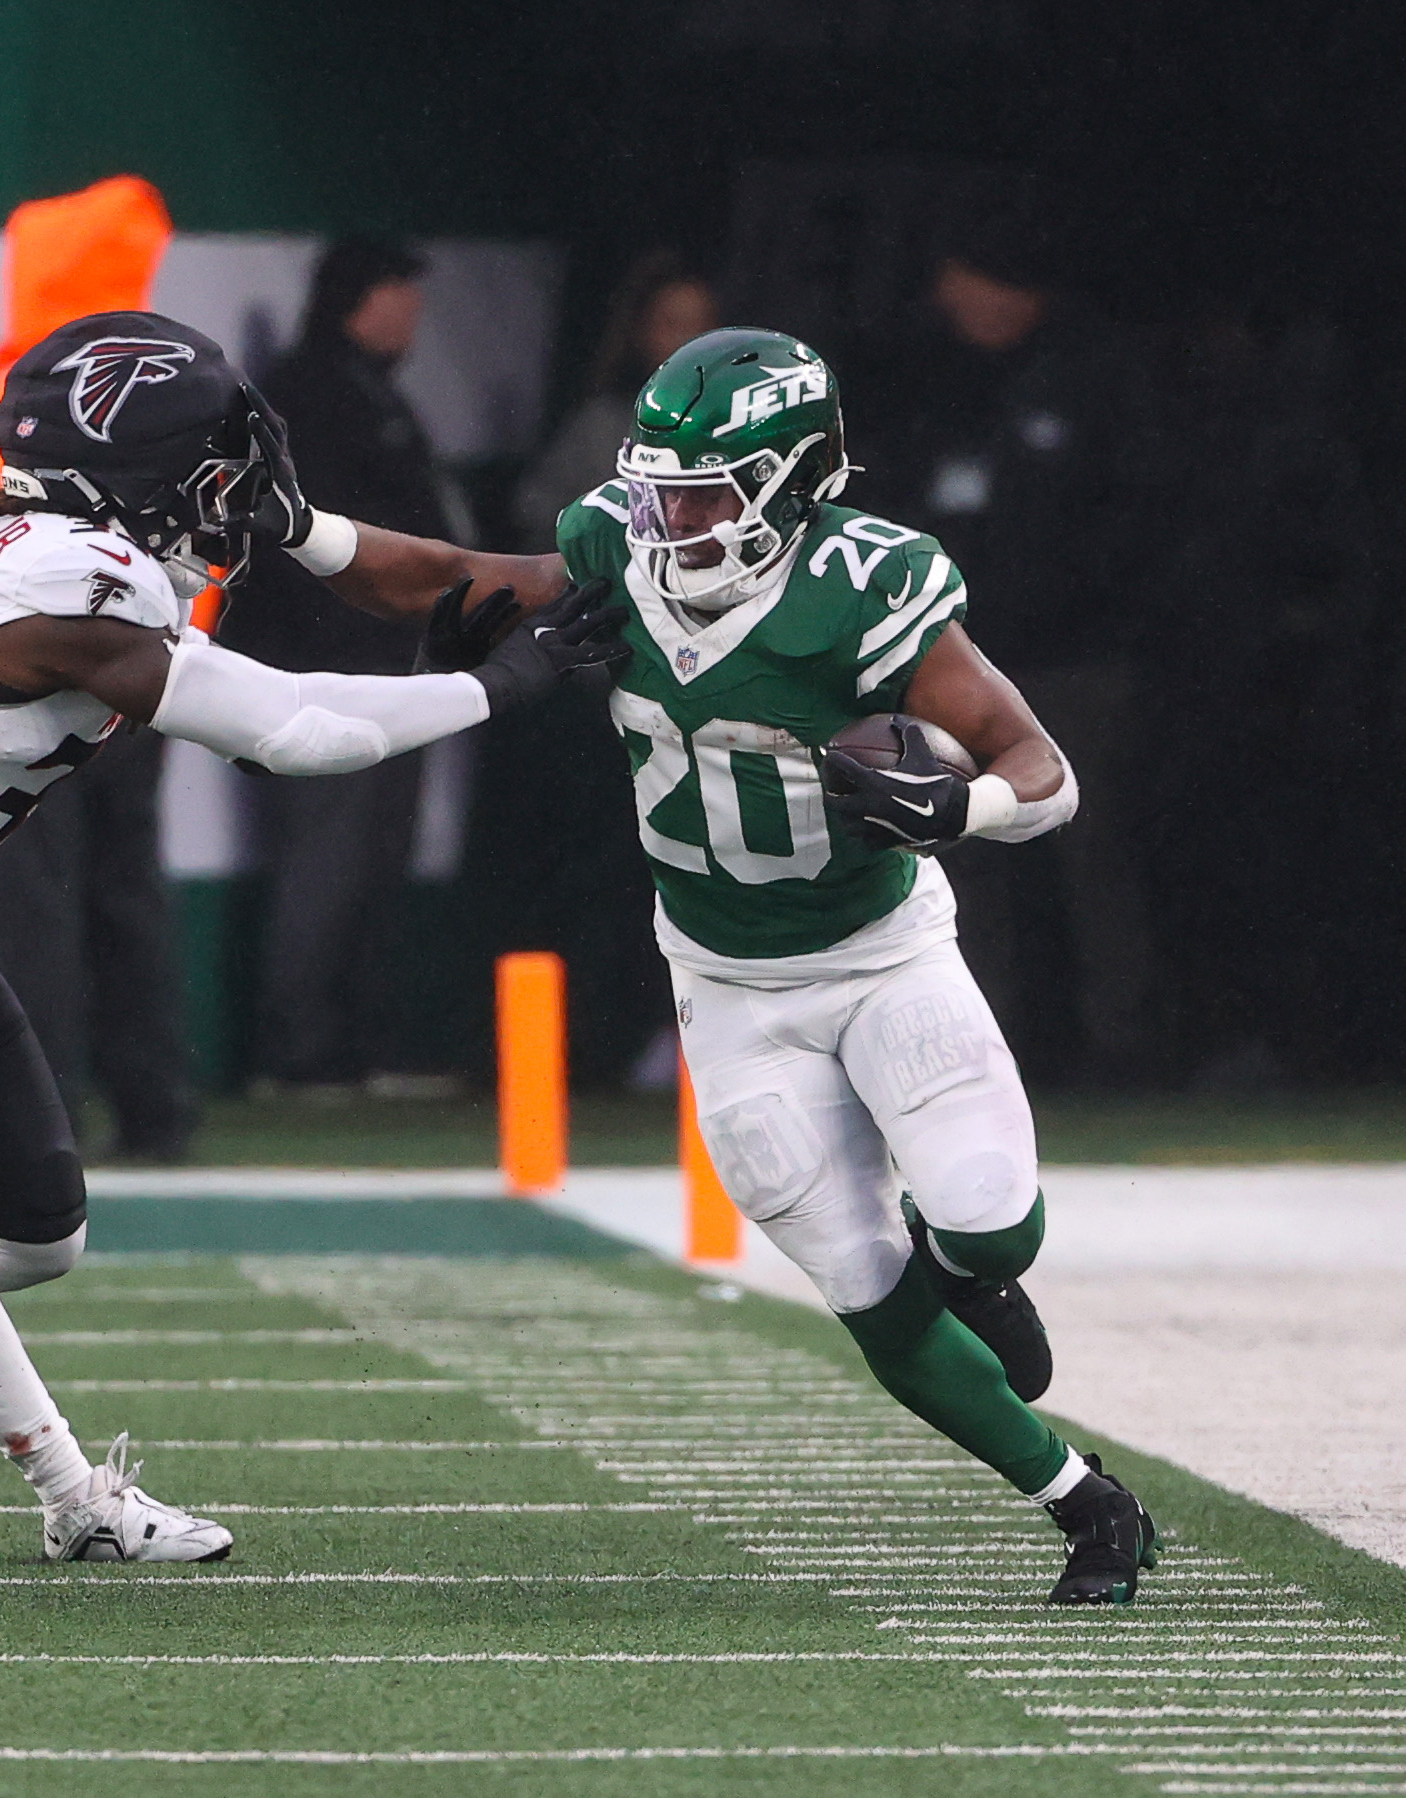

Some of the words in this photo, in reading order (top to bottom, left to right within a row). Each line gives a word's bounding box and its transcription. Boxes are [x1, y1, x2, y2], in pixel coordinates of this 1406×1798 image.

[712, 365, 827, 438] JETS
[638, 452, 662, 463] NY
[808, 515, 921, 592] 20
[608, 685, 833, 886] 20
[894, 1031, 980, 1093] BEAST
